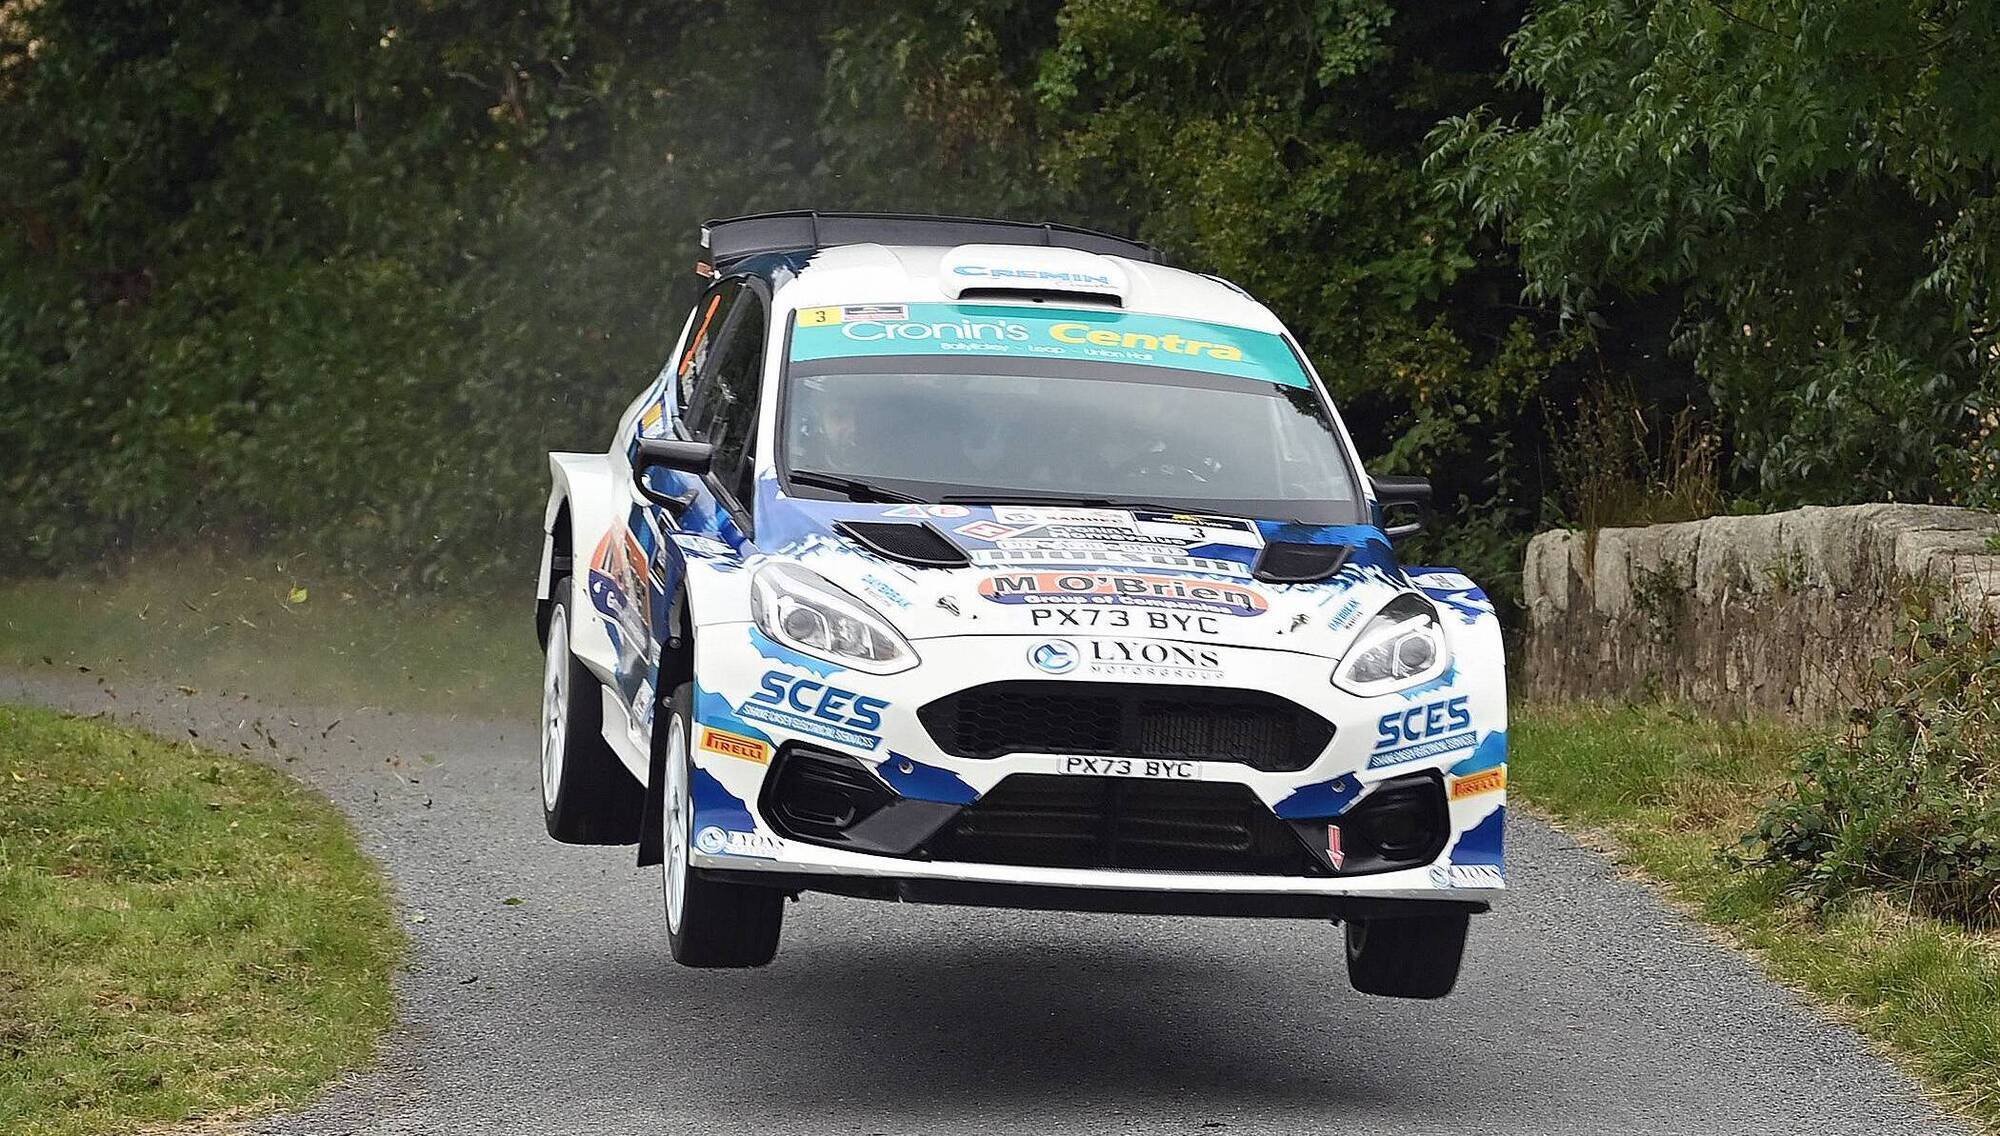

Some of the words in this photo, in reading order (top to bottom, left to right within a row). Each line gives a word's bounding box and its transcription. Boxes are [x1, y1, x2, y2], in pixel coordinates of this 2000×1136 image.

[953, 266, 1109, 285] CREMIN
[816, 310, 826, 323] 3
[842, 318, 1030, 342] Cronin's
[1049, 322, 1242, 362] Centra
[1190, 527, 1206, 538] 3
[995, 576, 1037, 593] M
[1058, 576, 1252, 609] O'Brien
[1024, 594, 1086, 606] Group
[1090, 595, 1113, 605] of
[1031, 608, 1130, 627] PX73
[1148, 611, 1220, 635] BYC
[1090, 641, 1220, 668] LYONS
[751, 670, 893, 731] SCES
[1375, 695, 1470, 750] SCES
[706, 732, 763, 759] PIRELLI
[1066, 757, 1132, 775] PX73
[1145, 761, 1193, 778] BYC
